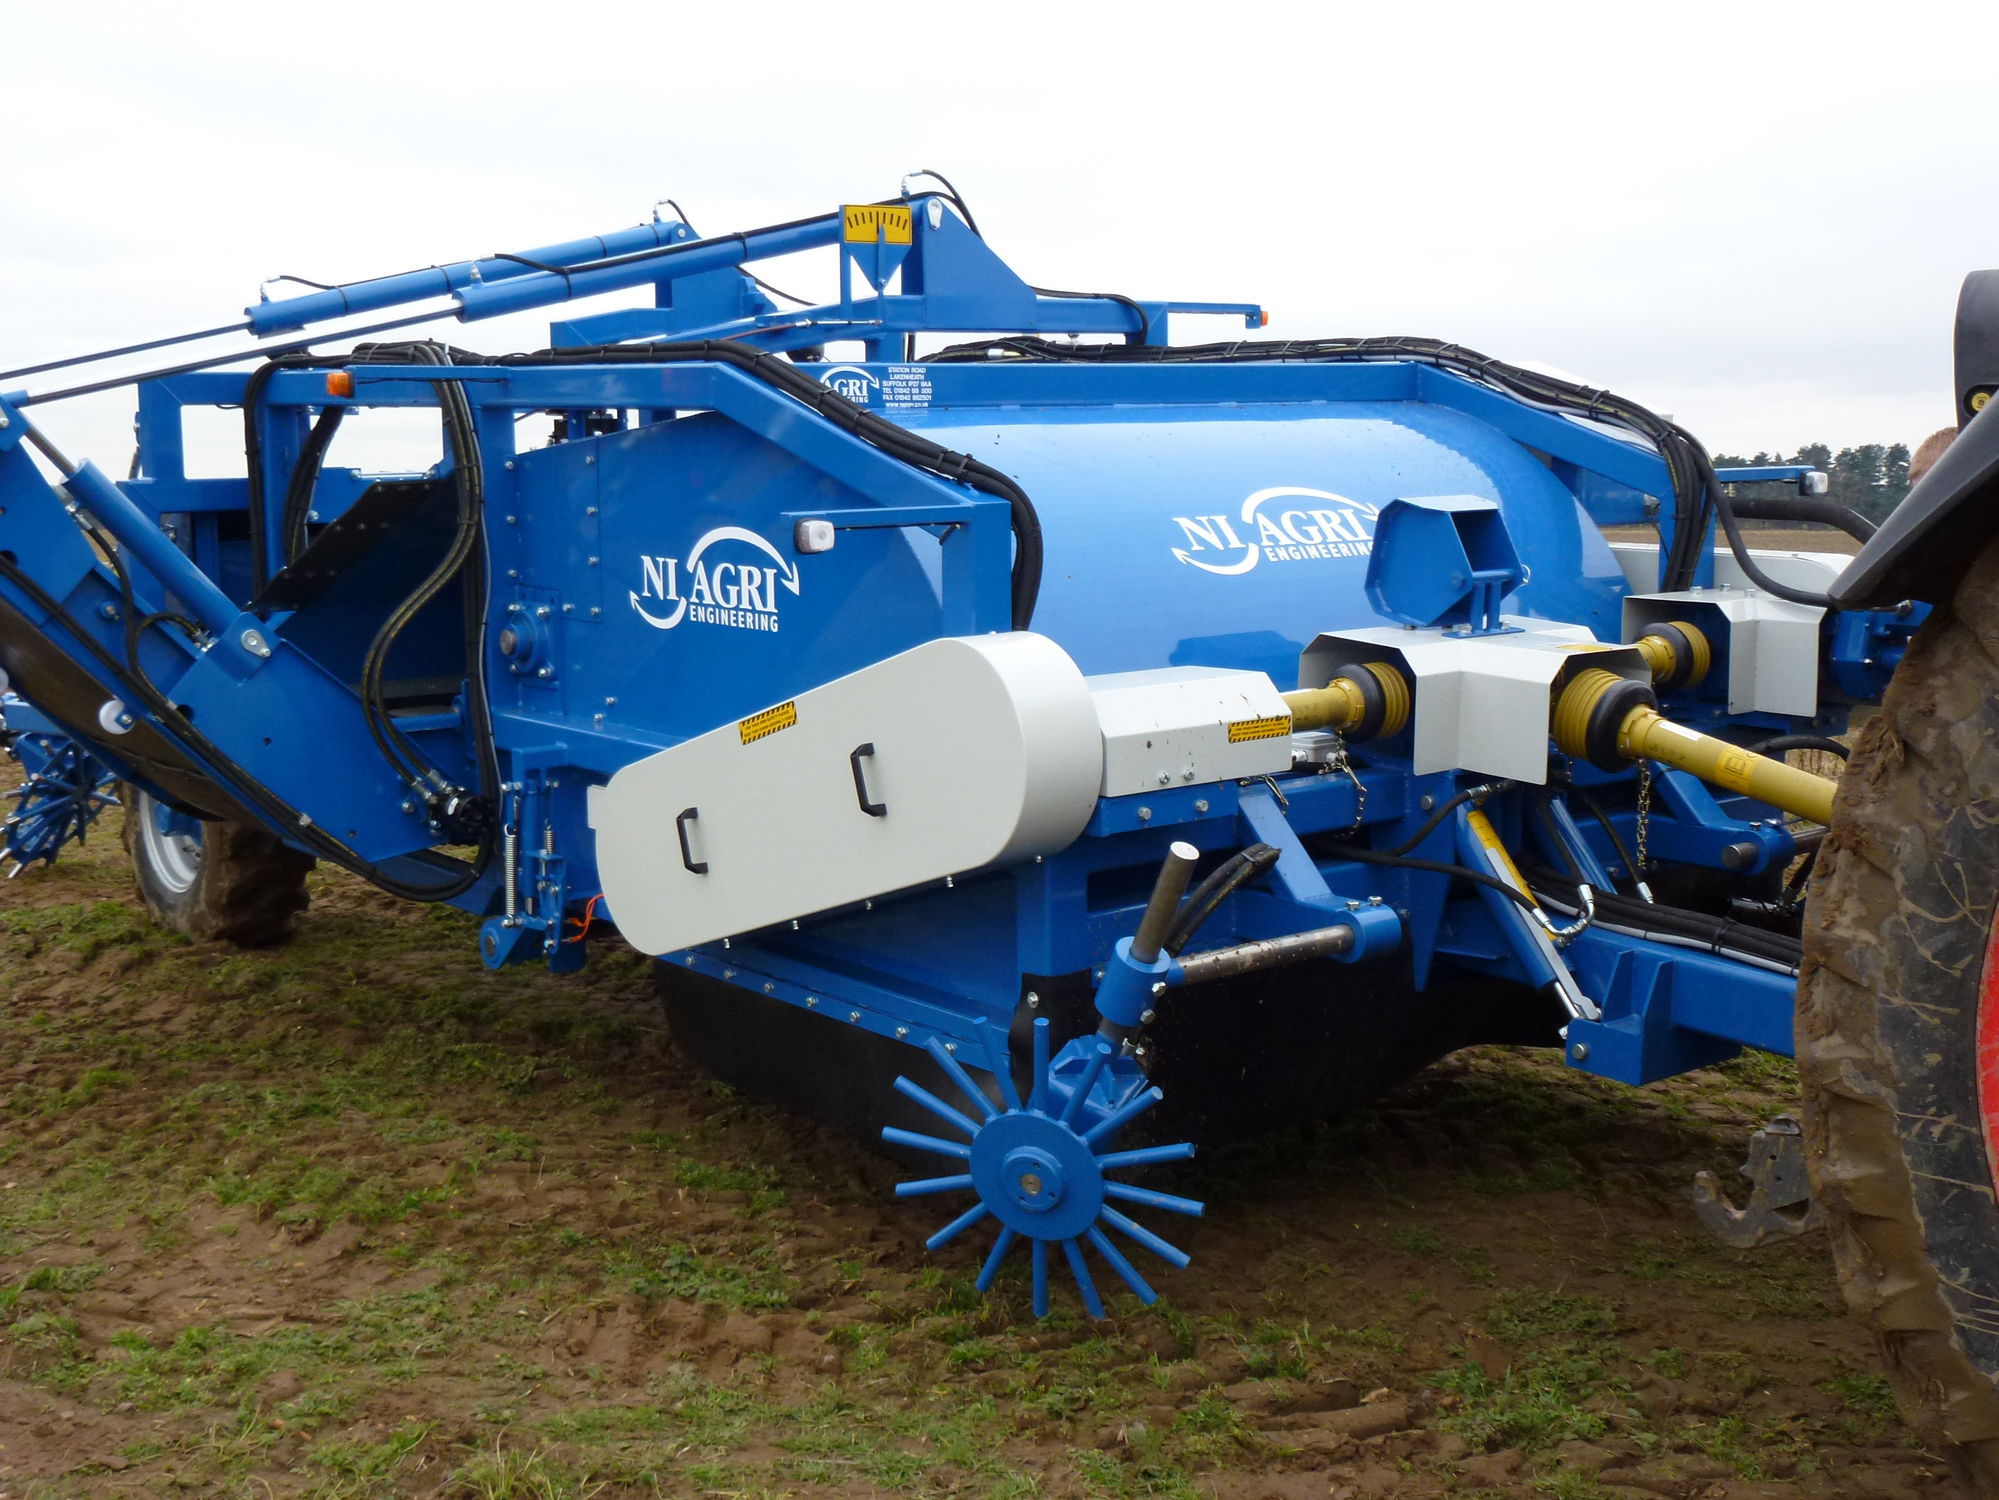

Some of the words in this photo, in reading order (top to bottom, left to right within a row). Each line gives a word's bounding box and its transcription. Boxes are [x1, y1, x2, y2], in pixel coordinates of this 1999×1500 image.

[1172, 515, 1246, 551] NI
[1256, 508, 1374, 547] AGRI
[641, 555, 679, 600] NI
[690, 560, 778, 613] AGRI
[690, 604, 778, 632] ENGINEERING
